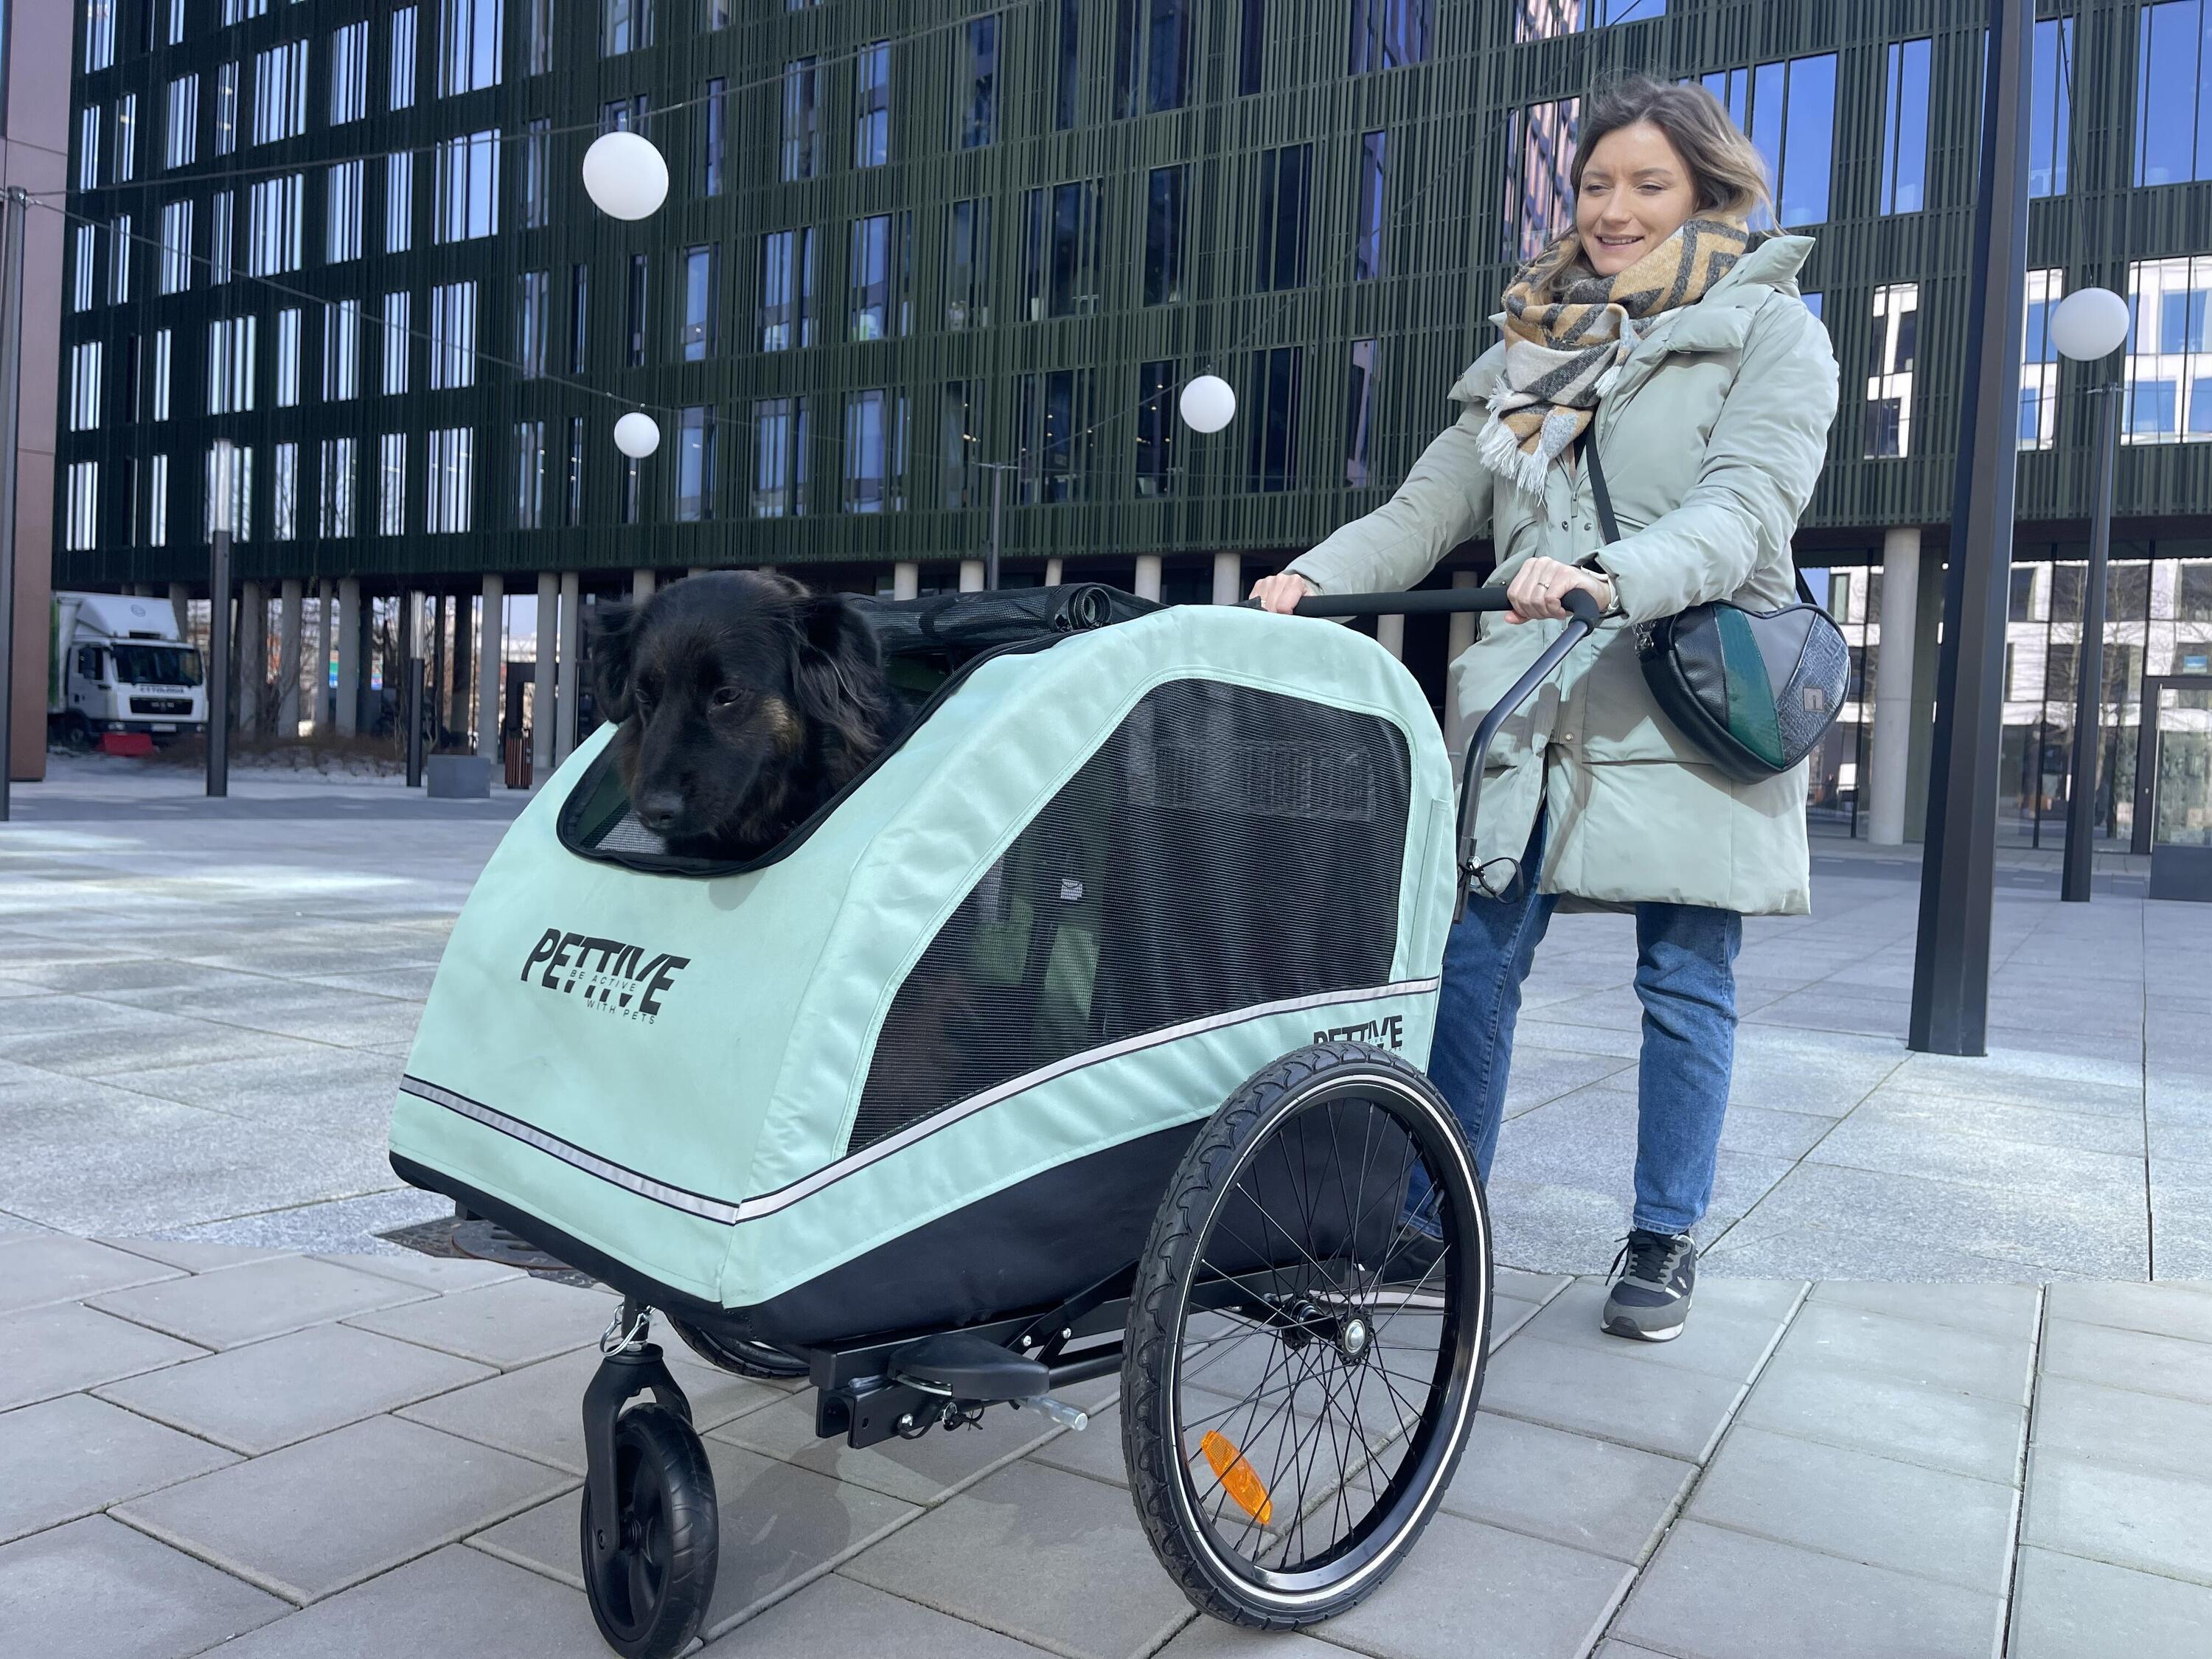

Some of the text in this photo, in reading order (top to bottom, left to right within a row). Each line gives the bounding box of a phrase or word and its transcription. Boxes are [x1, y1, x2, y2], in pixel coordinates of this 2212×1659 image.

[521, 928, 692, 1015] PETTIVE
[570, 969, 636, 992] BE ACTIVE
[587, 999, 655, 1025] WITH PETS
